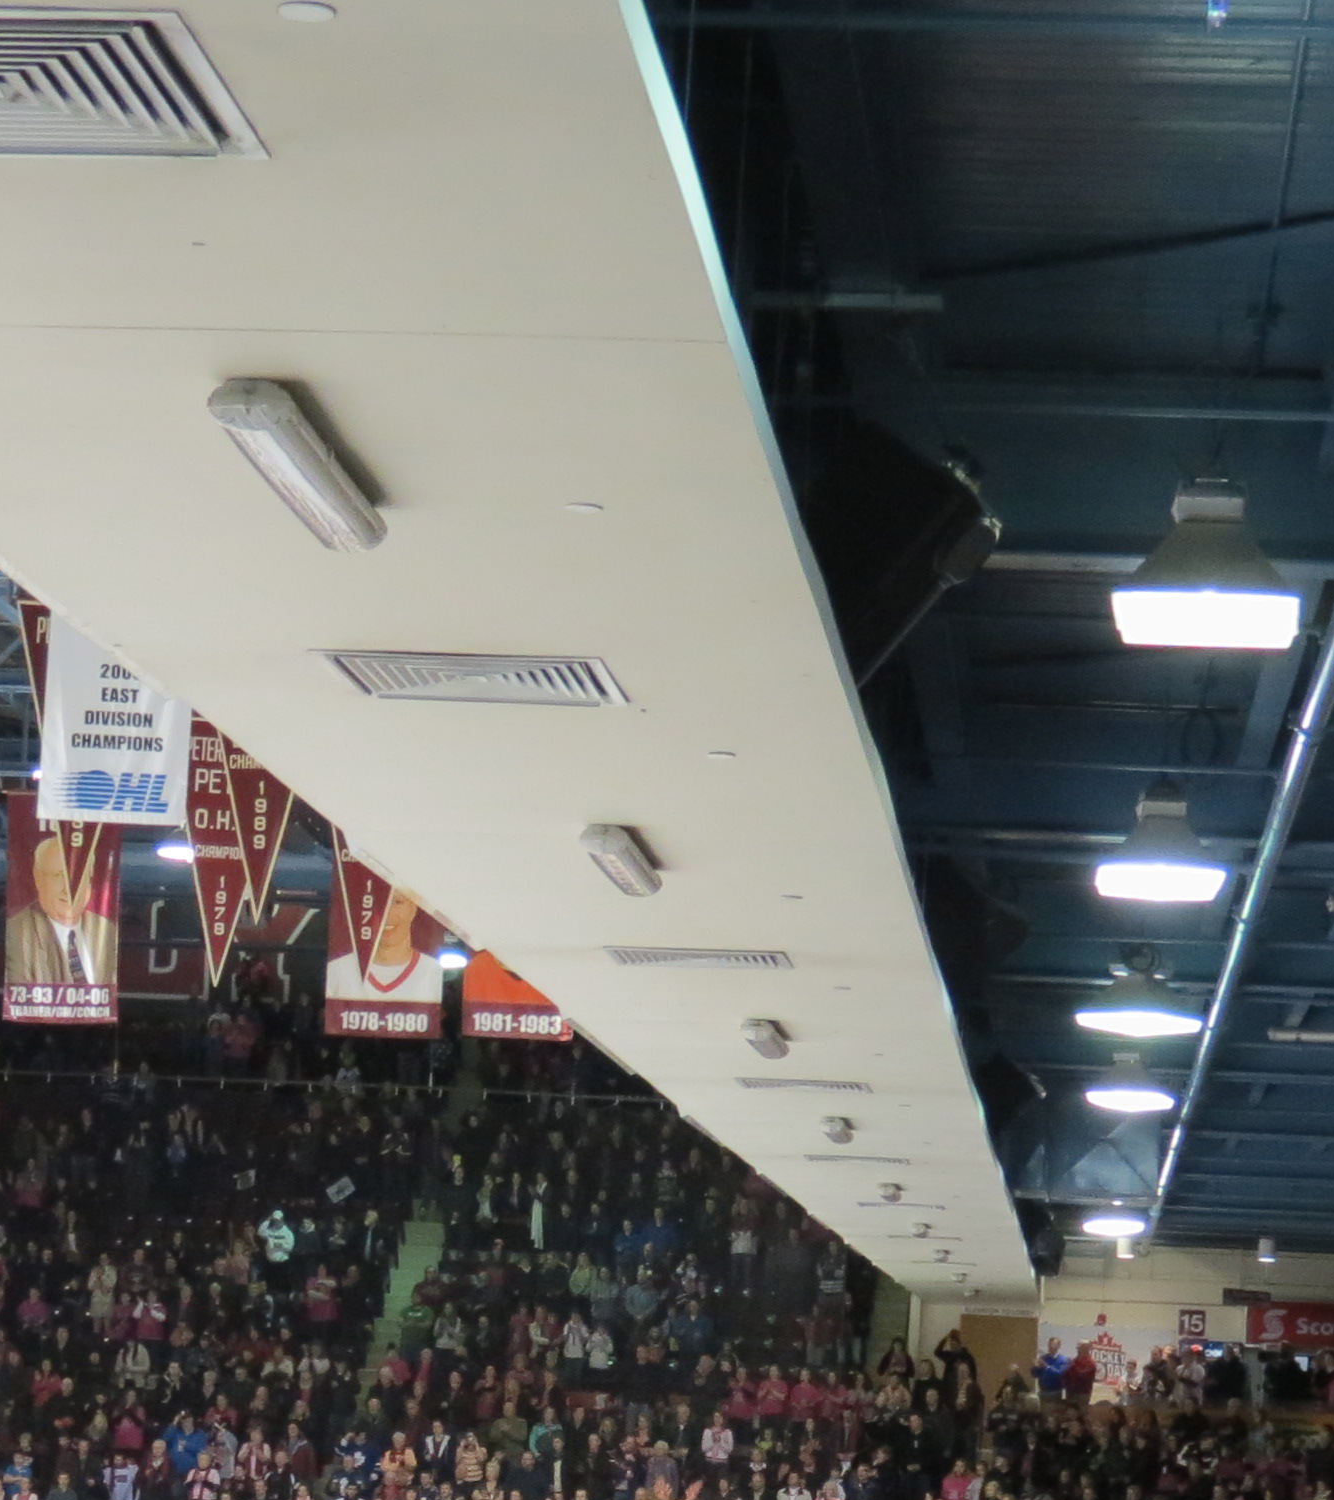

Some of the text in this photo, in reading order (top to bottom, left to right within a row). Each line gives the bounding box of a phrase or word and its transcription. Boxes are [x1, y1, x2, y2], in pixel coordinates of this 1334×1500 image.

[101, 687, 140, 704] EAST
[84, 710, 154, 729] DIVISION
[71, 733, 164, 753] CHAMPIONS
[10, 986, 54, 1004] 73-93
[66, 987, 110, 1005] 04-06
[339, 1010, 429, 1033] 1978-1980
[472, 1011, 562, 1035] 1981-1983
[1180, 1313, 1204, 1333] 15
